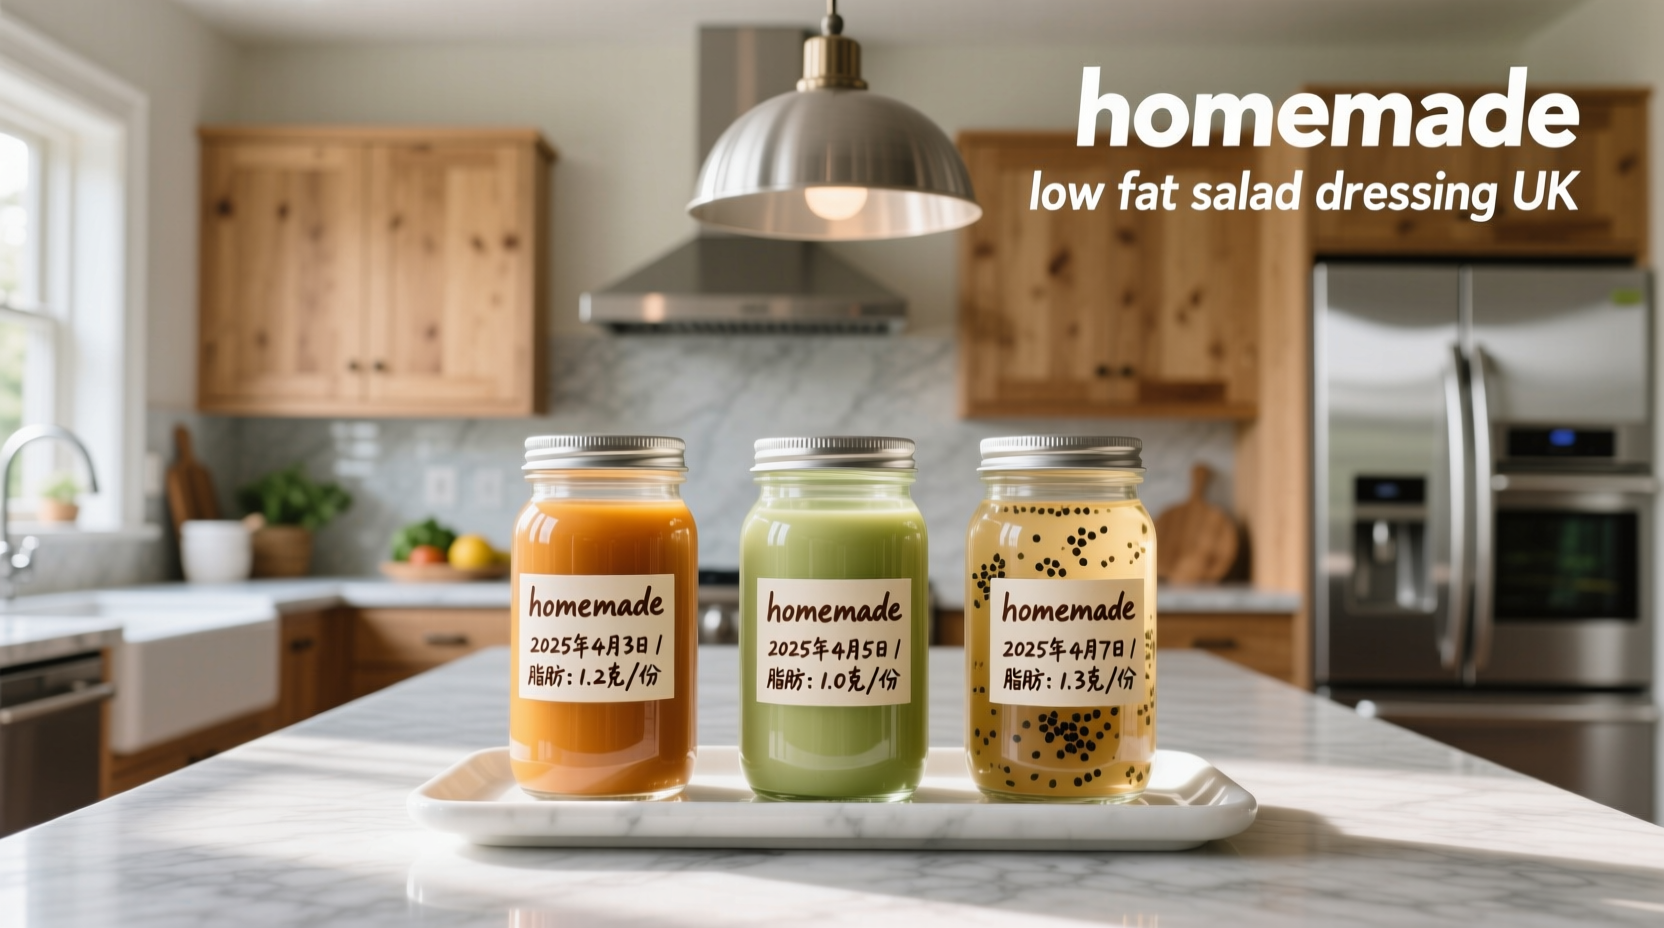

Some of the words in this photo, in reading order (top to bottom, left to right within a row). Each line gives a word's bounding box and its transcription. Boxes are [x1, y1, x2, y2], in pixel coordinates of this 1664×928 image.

[529, 584, 665, 618] homemade
[766, 589, 904, 624] homemade
[1001, 589, 1137, 623] homemade
